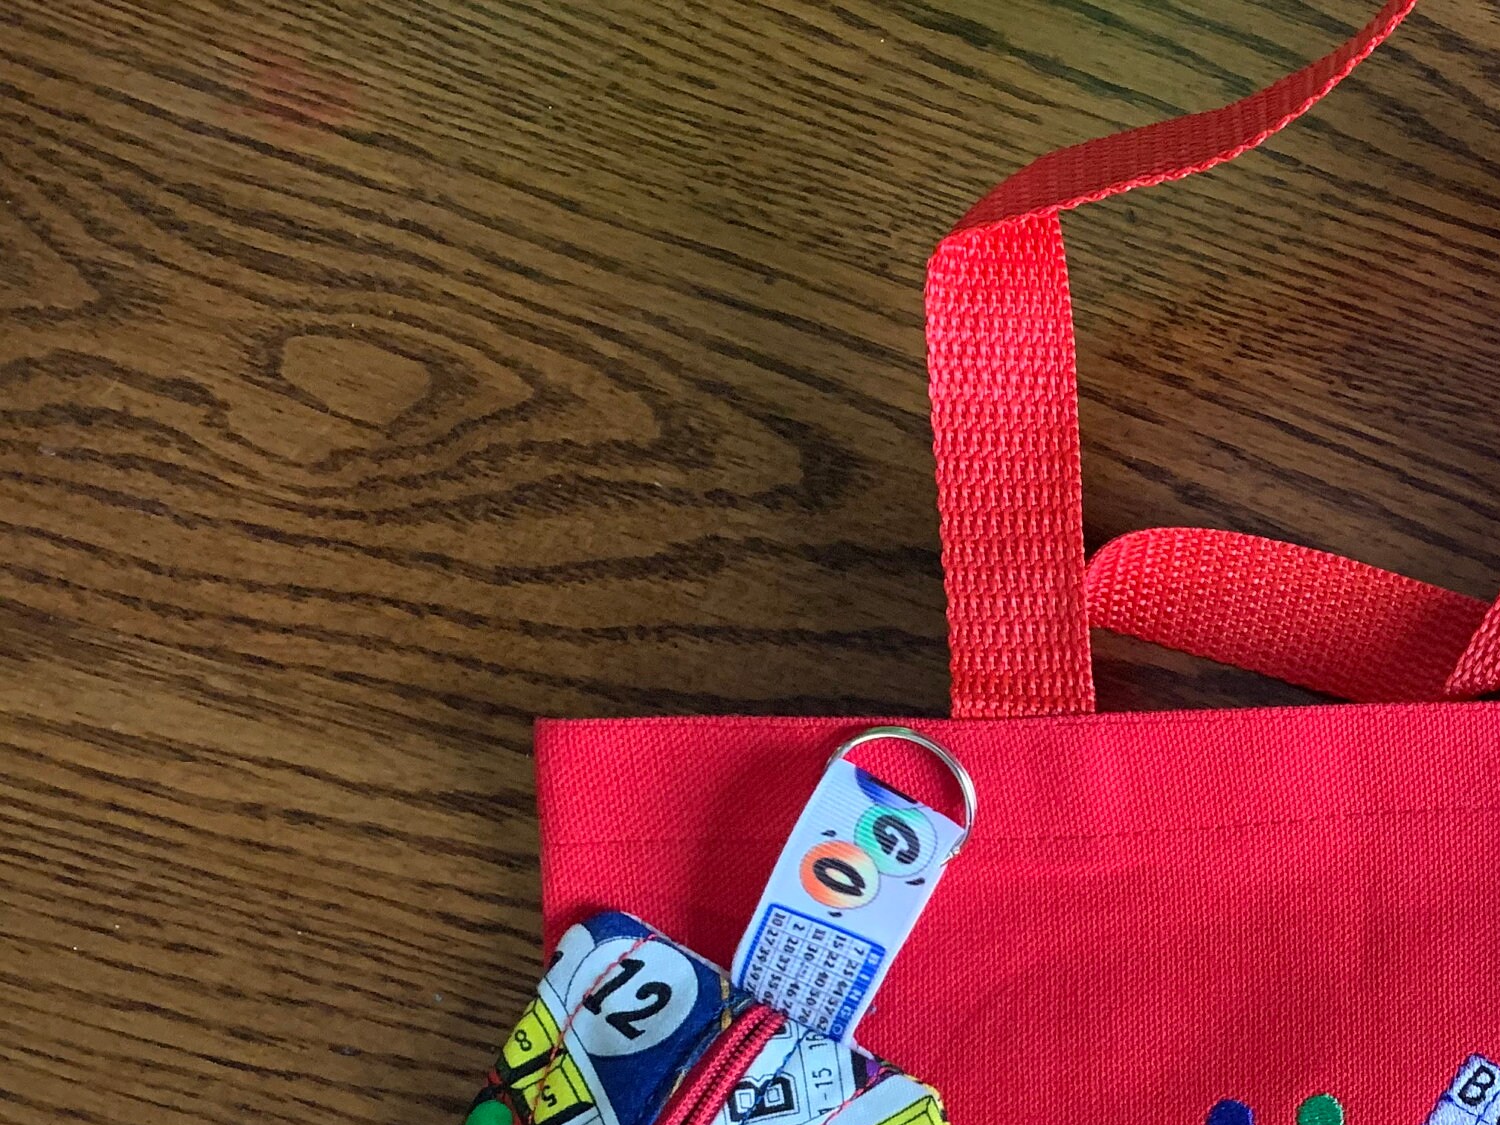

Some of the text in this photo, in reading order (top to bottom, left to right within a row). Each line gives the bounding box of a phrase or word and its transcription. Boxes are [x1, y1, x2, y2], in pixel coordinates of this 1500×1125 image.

[582, 958, 673, 1040] 12
[514, 1029, 532, 1051] 8
[541, 1086, 558, 1107] 5
